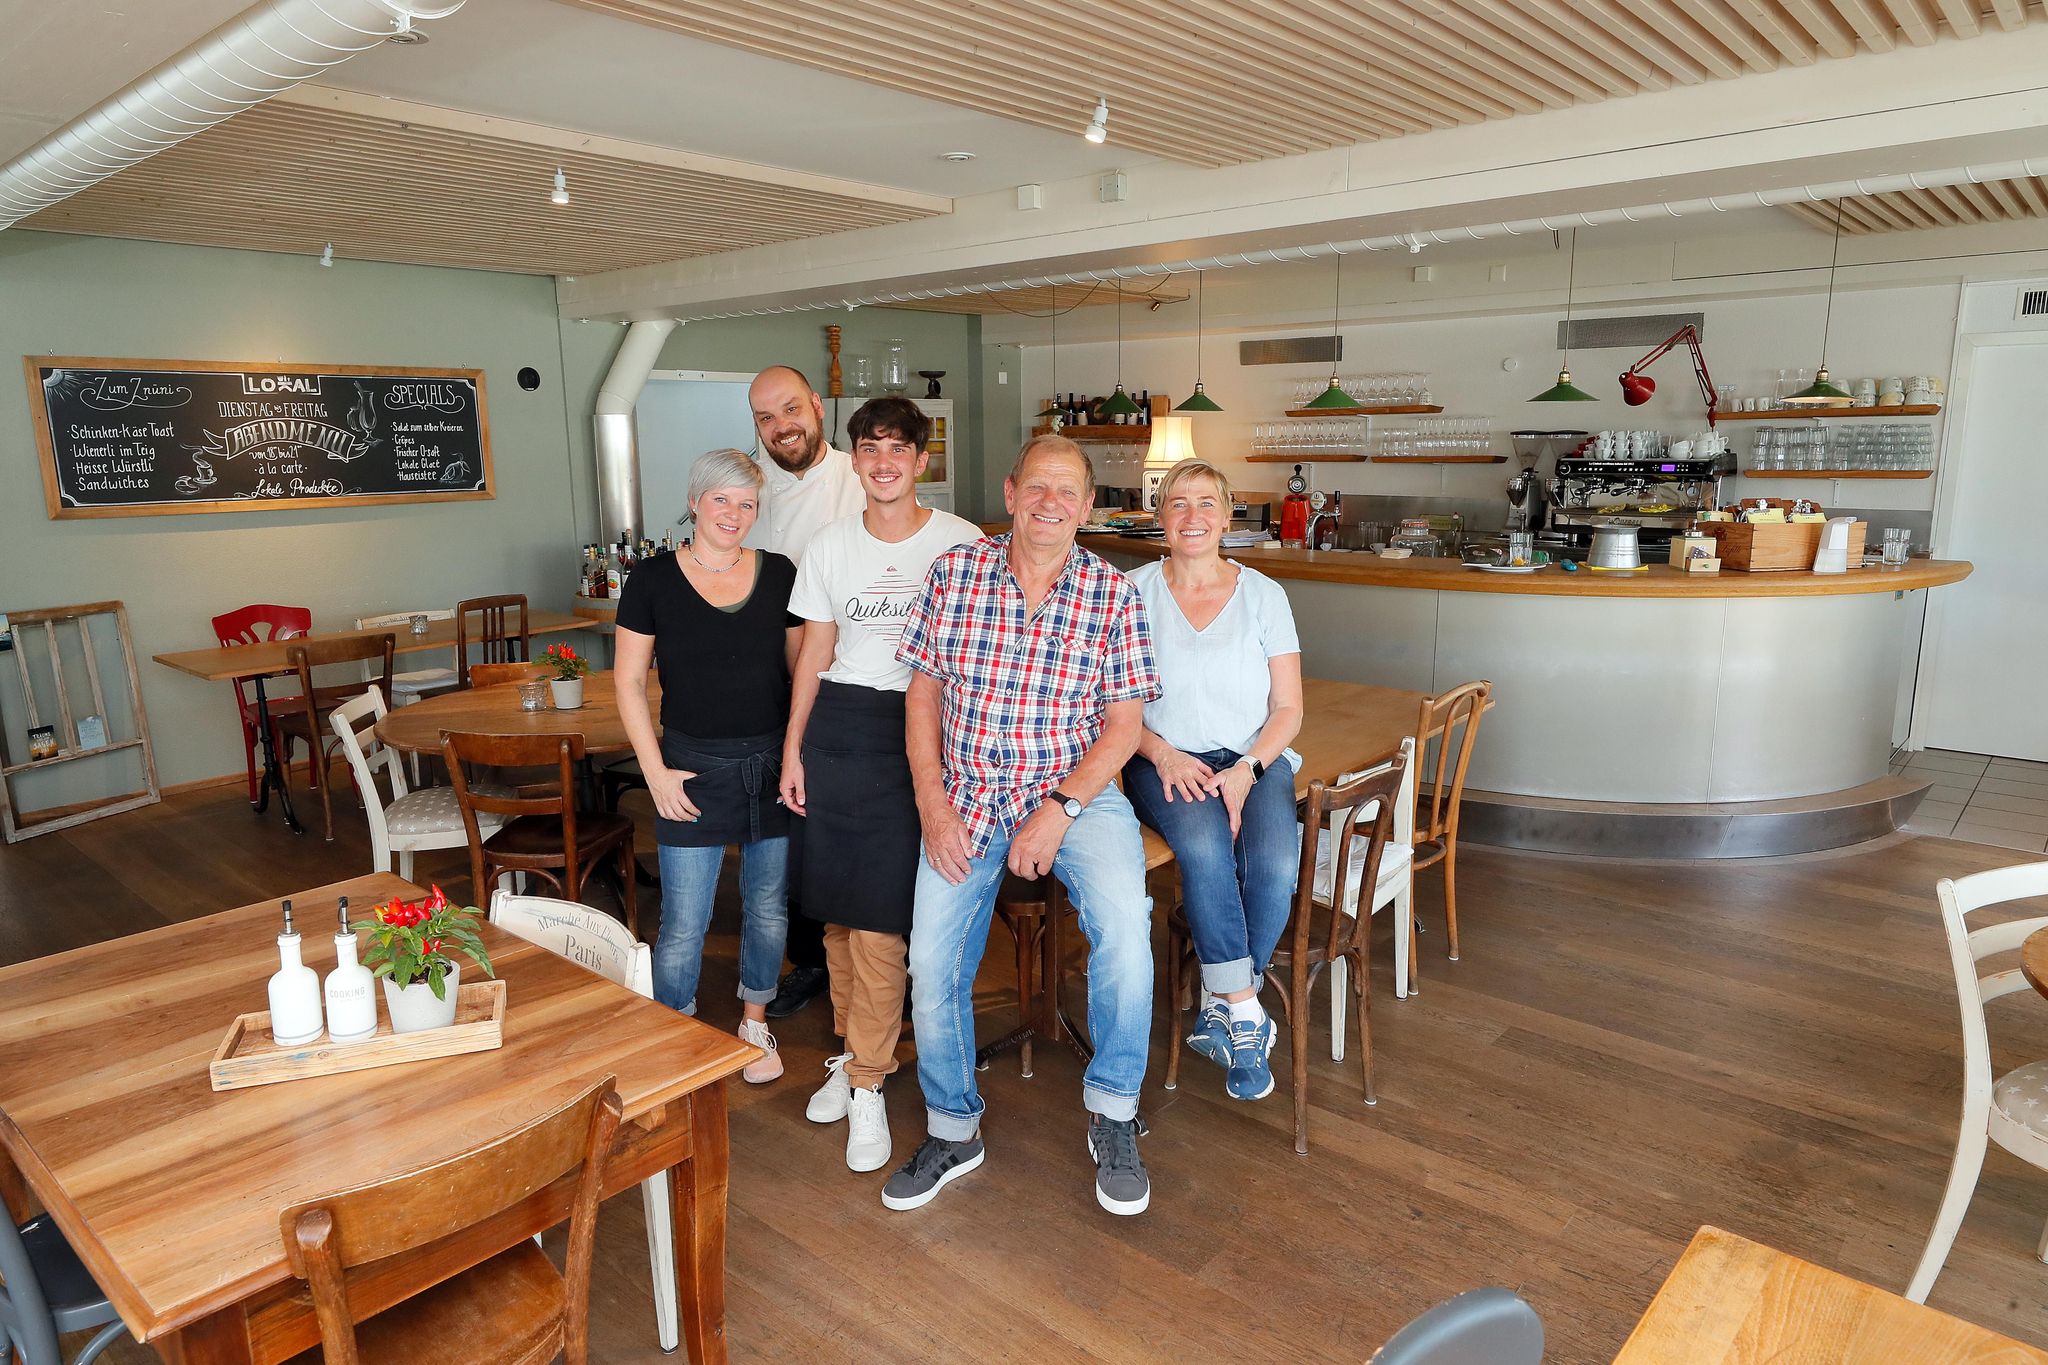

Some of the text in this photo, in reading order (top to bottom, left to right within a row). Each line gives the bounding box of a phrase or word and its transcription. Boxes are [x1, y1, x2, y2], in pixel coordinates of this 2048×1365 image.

[94, 377, 129, 401] Zum
[391, 384, 456, 406] SPECIALS
[217, 401, 274, 418] DIENSTAG
[283, 402, 329, 418] FREITAG
[70, 421, 175, 440] Schinken-Käse Toast
[392, 421, 409, 432] Salat
[410, 424, 423, 432] zum
[394, 433, 415, 448] Crêpes
[73, 442, 156, 460] Wienerli im Teig
[249, 451, 266, 460] von
[277, 446, 291, 459] bis
[395, 446, 419, 457] Frischer
[75, 458, 154, 475] Heisse Würstli
[258, 460, 304, 475] à la carte
[397, 459, 420, 470] Lokale
[78, 474, 150, 491] Sandwiches
[251, 478, 285, 498] Lokale
[845, 595, 918, 622] Quiksil
[582, 914, 602, 935] Aux
[563, 934, 602, 971] Paris
